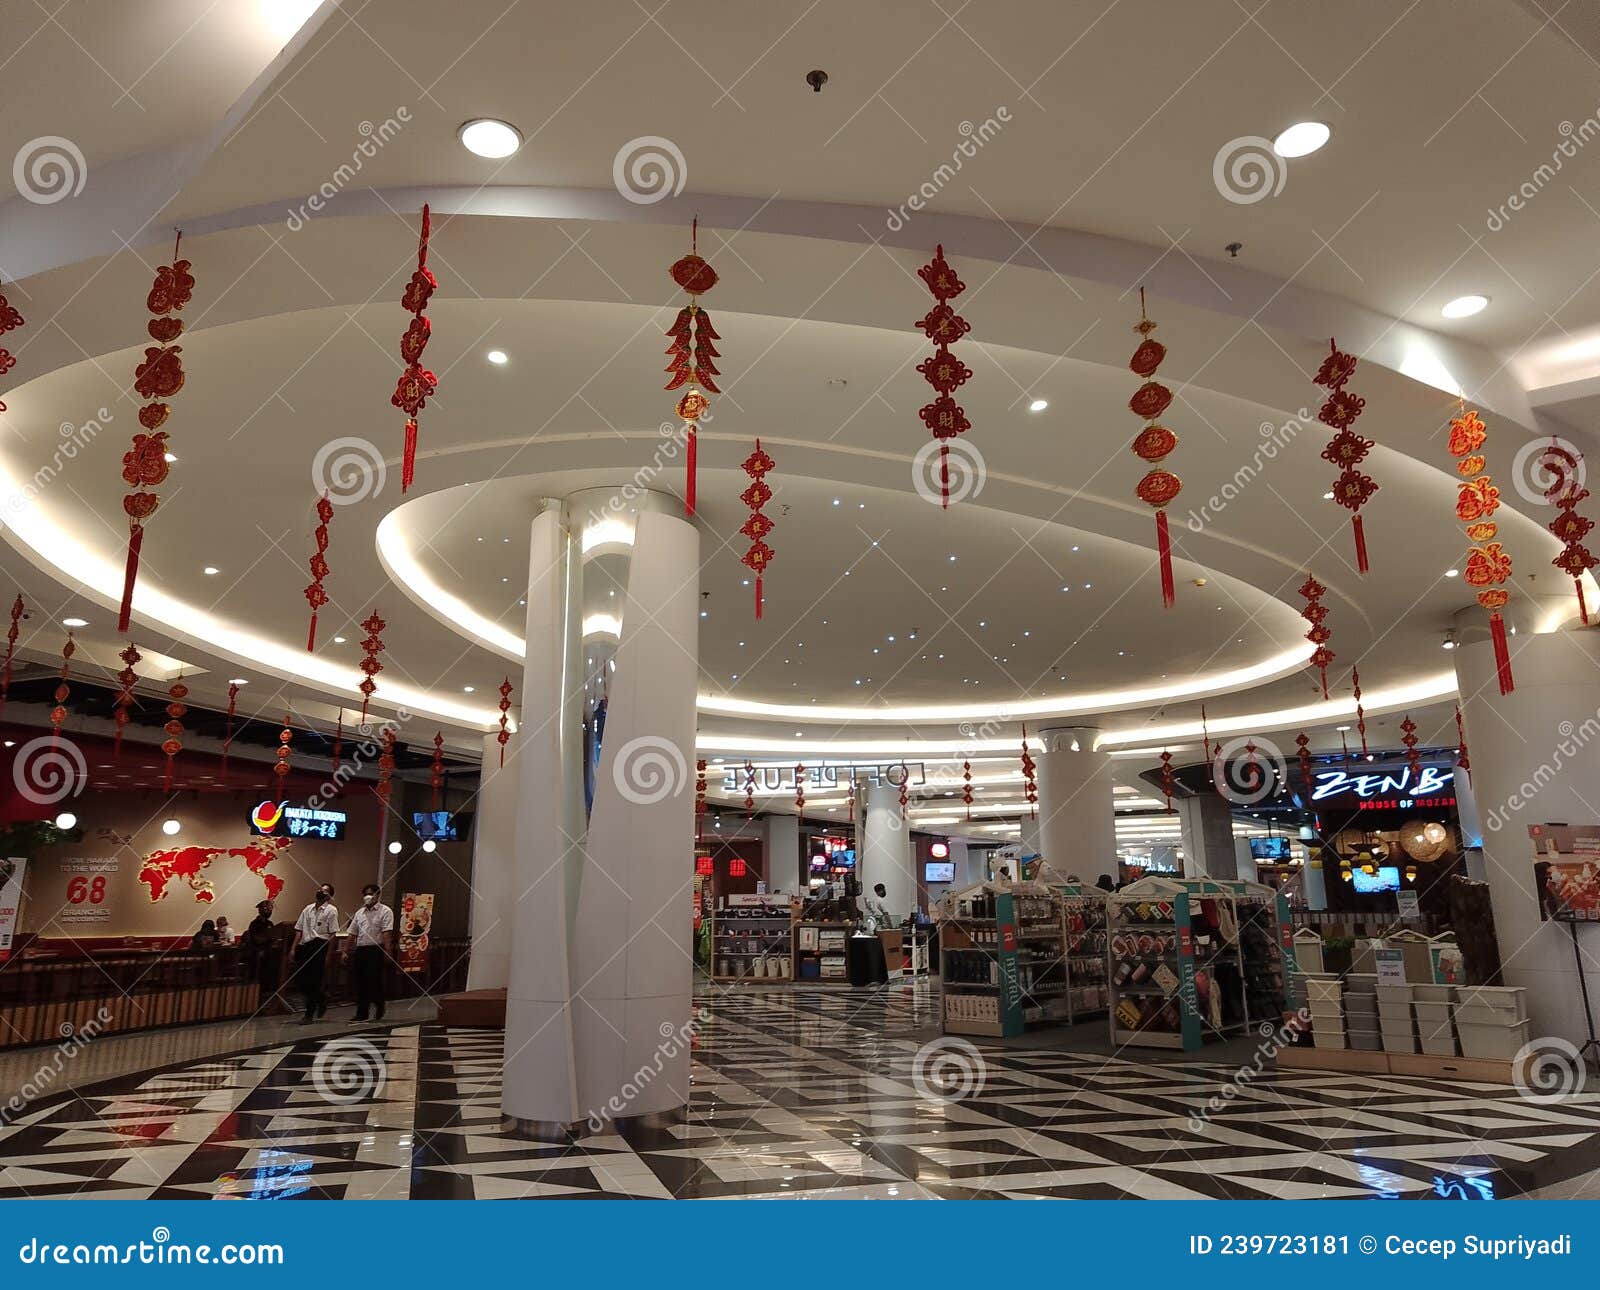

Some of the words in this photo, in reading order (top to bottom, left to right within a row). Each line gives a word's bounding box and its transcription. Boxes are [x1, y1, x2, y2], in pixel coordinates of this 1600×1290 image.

[1359, 799, 1398, 809] HOUSE
[1400, 799, 1414, 808] OF
[67, 876, 106, 904] 68
